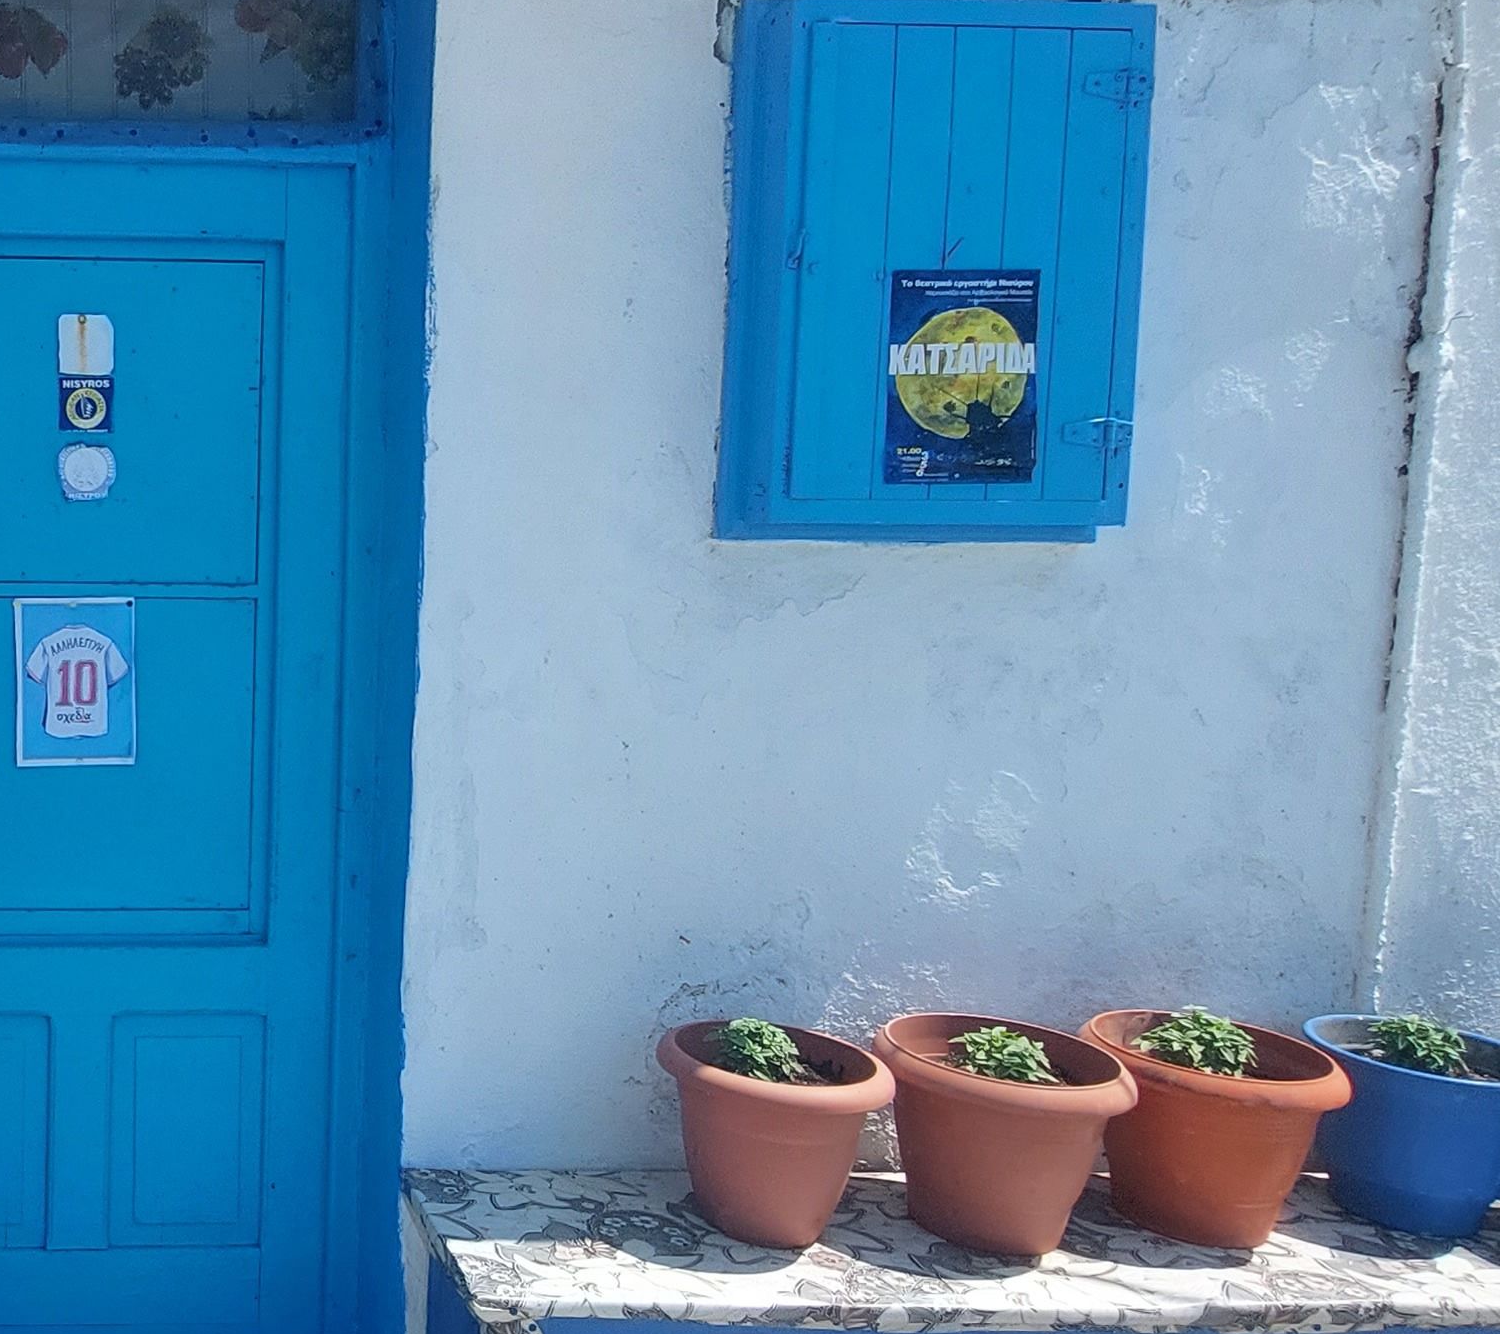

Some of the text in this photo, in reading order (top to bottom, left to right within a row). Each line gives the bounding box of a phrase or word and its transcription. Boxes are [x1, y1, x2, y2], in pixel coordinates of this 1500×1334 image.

[888, 342, 1037, 376] ΚΑΤΣΑΡΙΔΑ
[62, 379, 110, 389] NISYROS
[55, 659, 99, 707] 10
